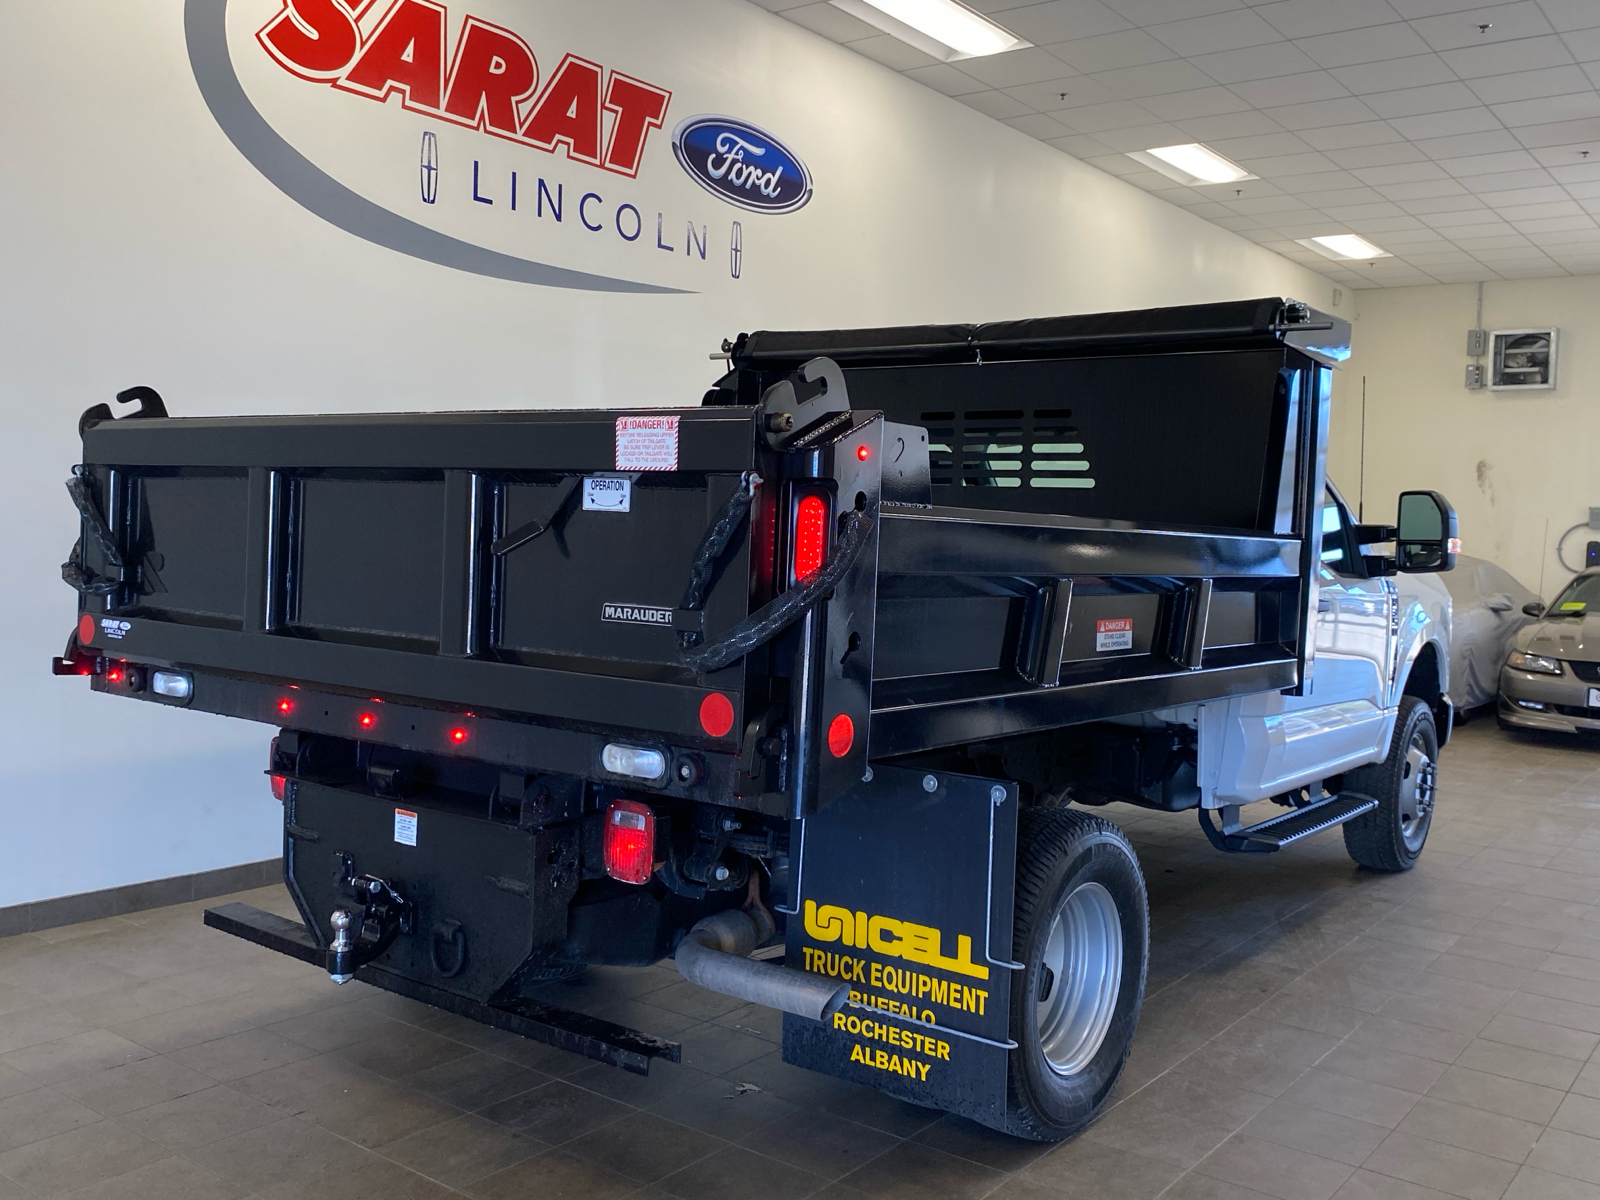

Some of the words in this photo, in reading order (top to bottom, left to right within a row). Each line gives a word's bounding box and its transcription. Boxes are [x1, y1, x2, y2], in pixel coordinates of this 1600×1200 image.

[255, 0, 672, 179] SARAT
[706, 132, 785, 199] Ford
[473, 160, 708, 261] LINCOLN
[590, 479, 624, 491] OPERATION
[1105, 621, 1125, 630] DANGER
[1111, 640, 1129, 648] OPERATING
[804, 899, 989, 980] UNICELL
[802, 946, 866, 984] TRUCK
[870, 961, 989, 1016] EQUIPMENT
[833, 1012, 950, 1061] ROCHESTER
[850, 1043, 932, 1082] ALBANY
